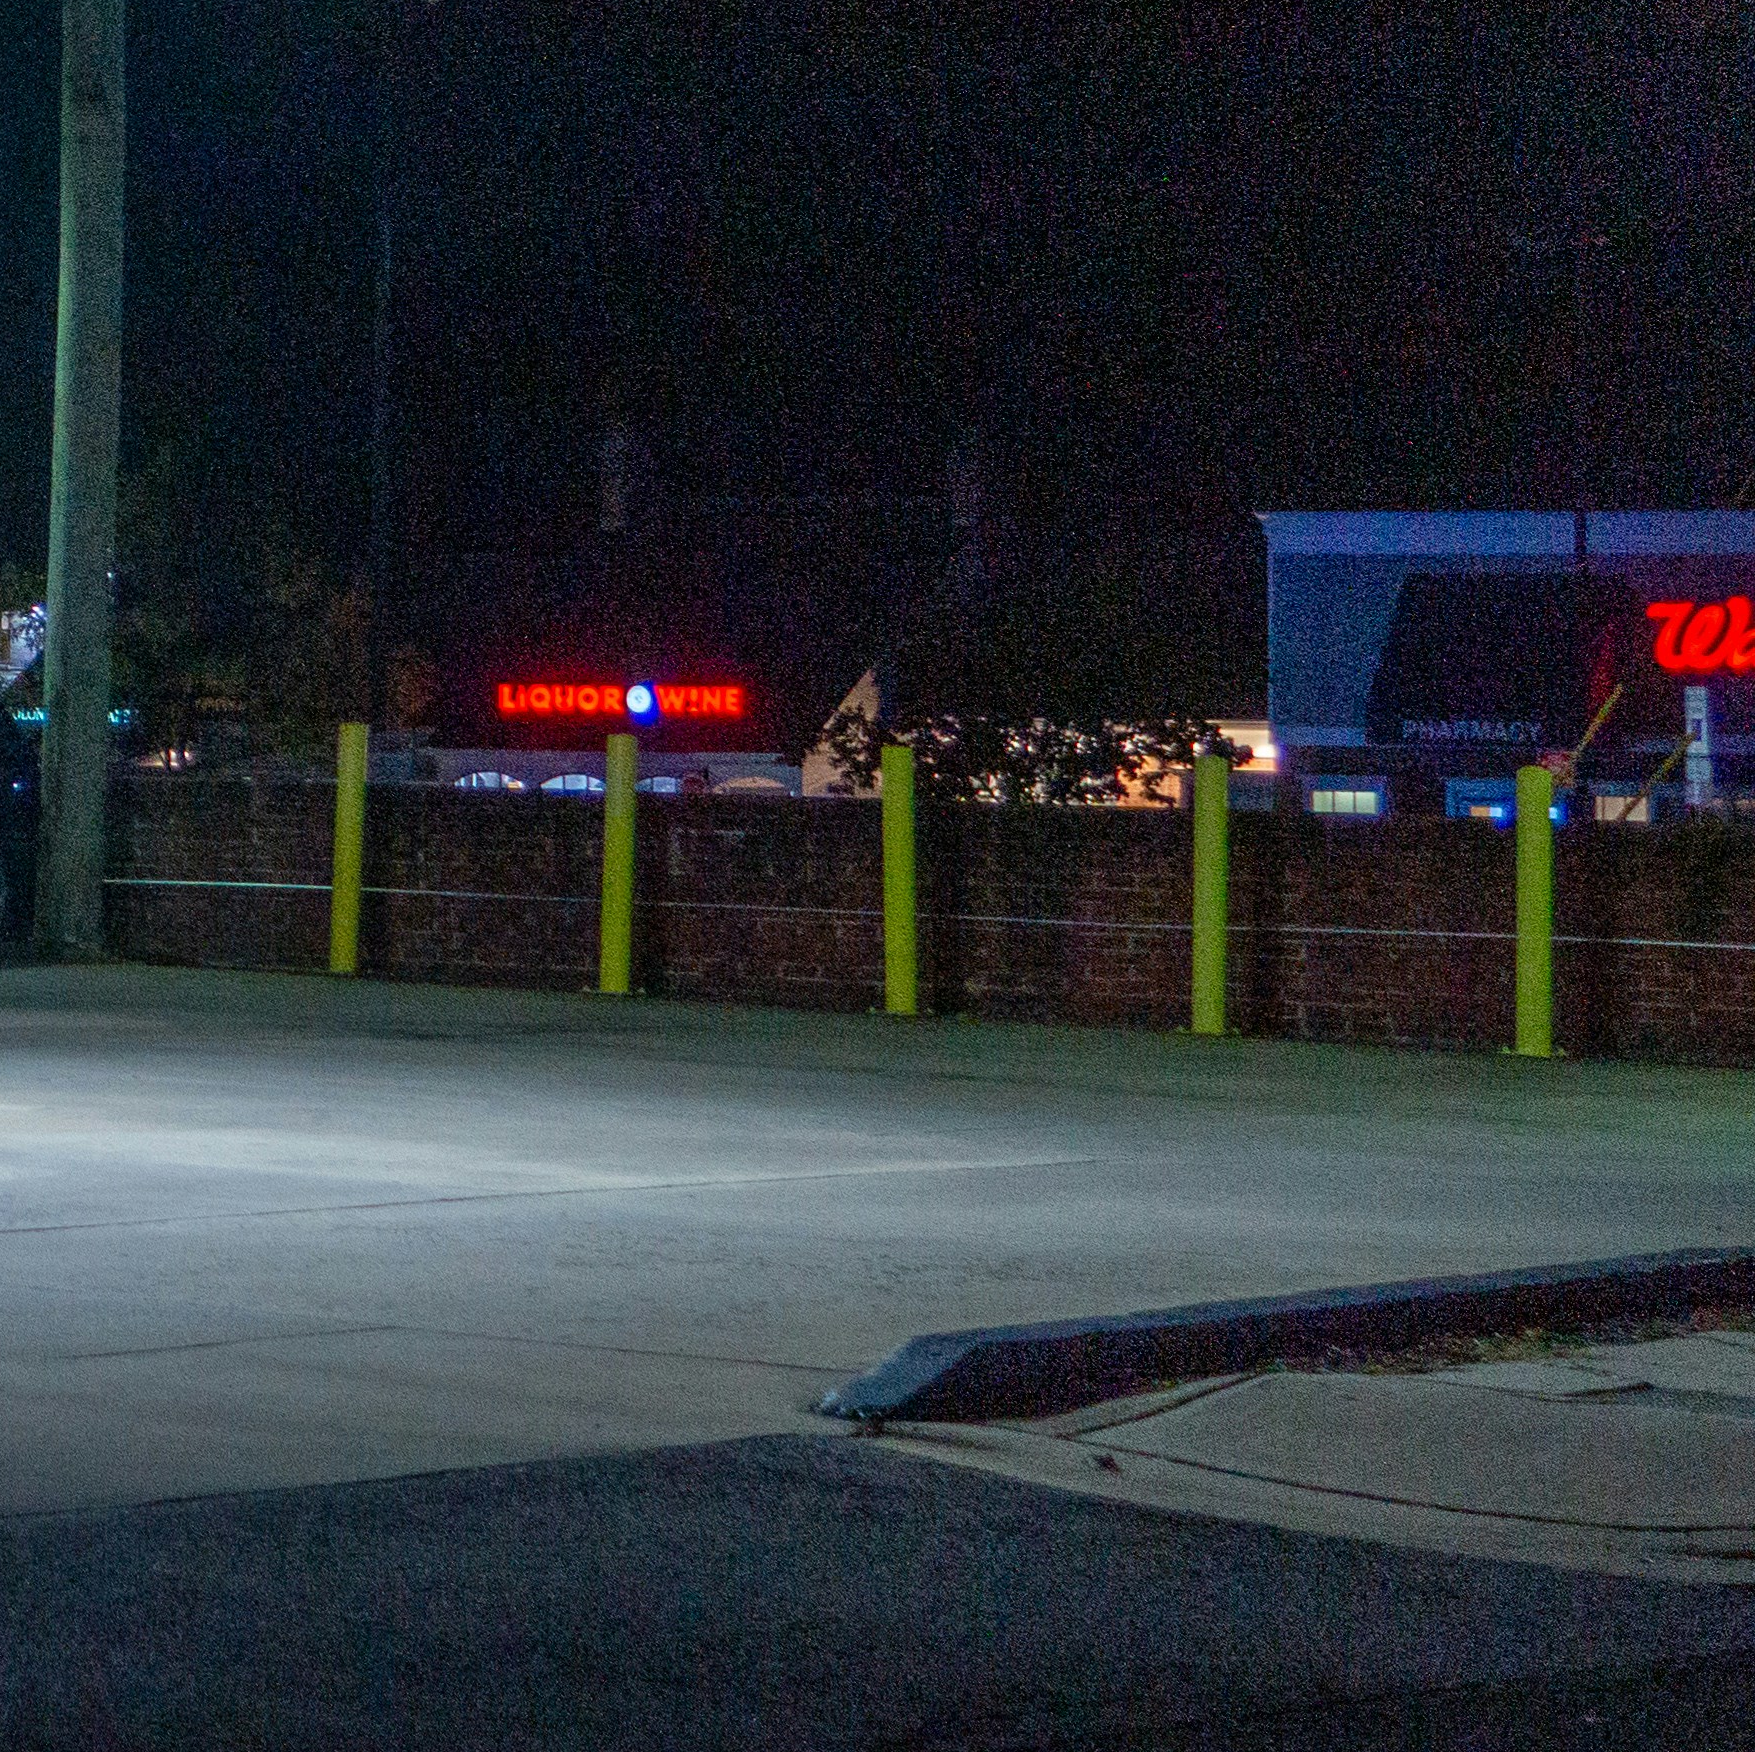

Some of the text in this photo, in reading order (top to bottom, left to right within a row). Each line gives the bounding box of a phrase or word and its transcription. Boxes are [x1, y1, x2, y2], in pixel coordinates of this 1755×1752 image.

[500, 684, 742, 712] LIQUOR WINE
[1402, 719, 1542, 742] PHARMACY
